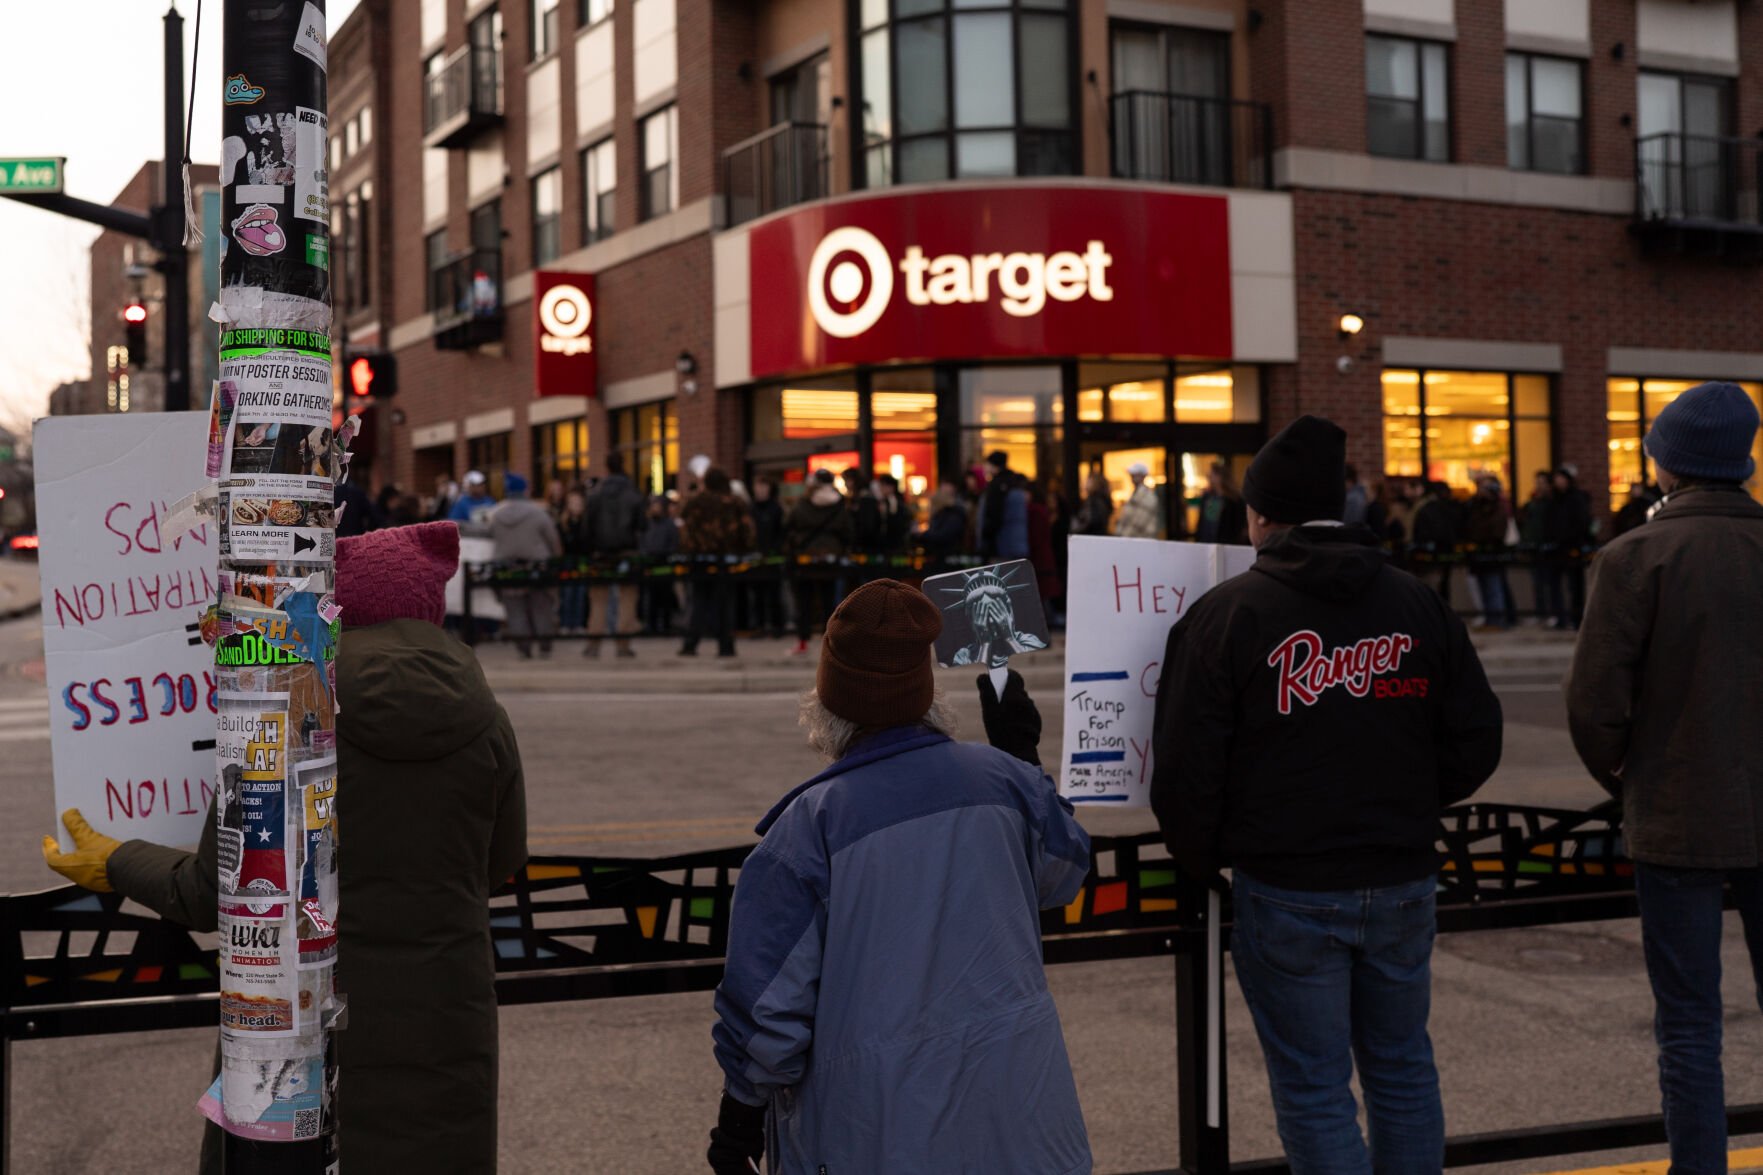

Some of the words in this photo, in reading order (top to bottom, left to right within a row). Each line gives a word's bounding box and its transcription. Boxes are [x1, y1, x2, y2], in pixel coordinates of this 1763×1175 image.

[12, 162, 54, 186] Ave
[900, 240, 1113, 317] target
[235, 329, 285, 345] SHIPPING
[287, 330, 307, 346] FOR
[246, 364, 290, 379] POSTER
[292, 365, 329, 385] SESSION
[1112, 564, 1187, 615] HEY
[1268, 629, 1412, 715] Ranger
[1373, 677, 1430, 699] BOATS
[62, 671, 218, 731] ROCESS
[1071, 690, 1126, 720] Trump
[1089, 716, 1114, 730] For
[1078, 730, 1126, 750] Prison
[251, 783, 282, 792] ACTION
[247, 811, 263, 820] OIL!
[232, 957, 280, 965] ANIMATION
[239, 1013, 280, 1026] head.
